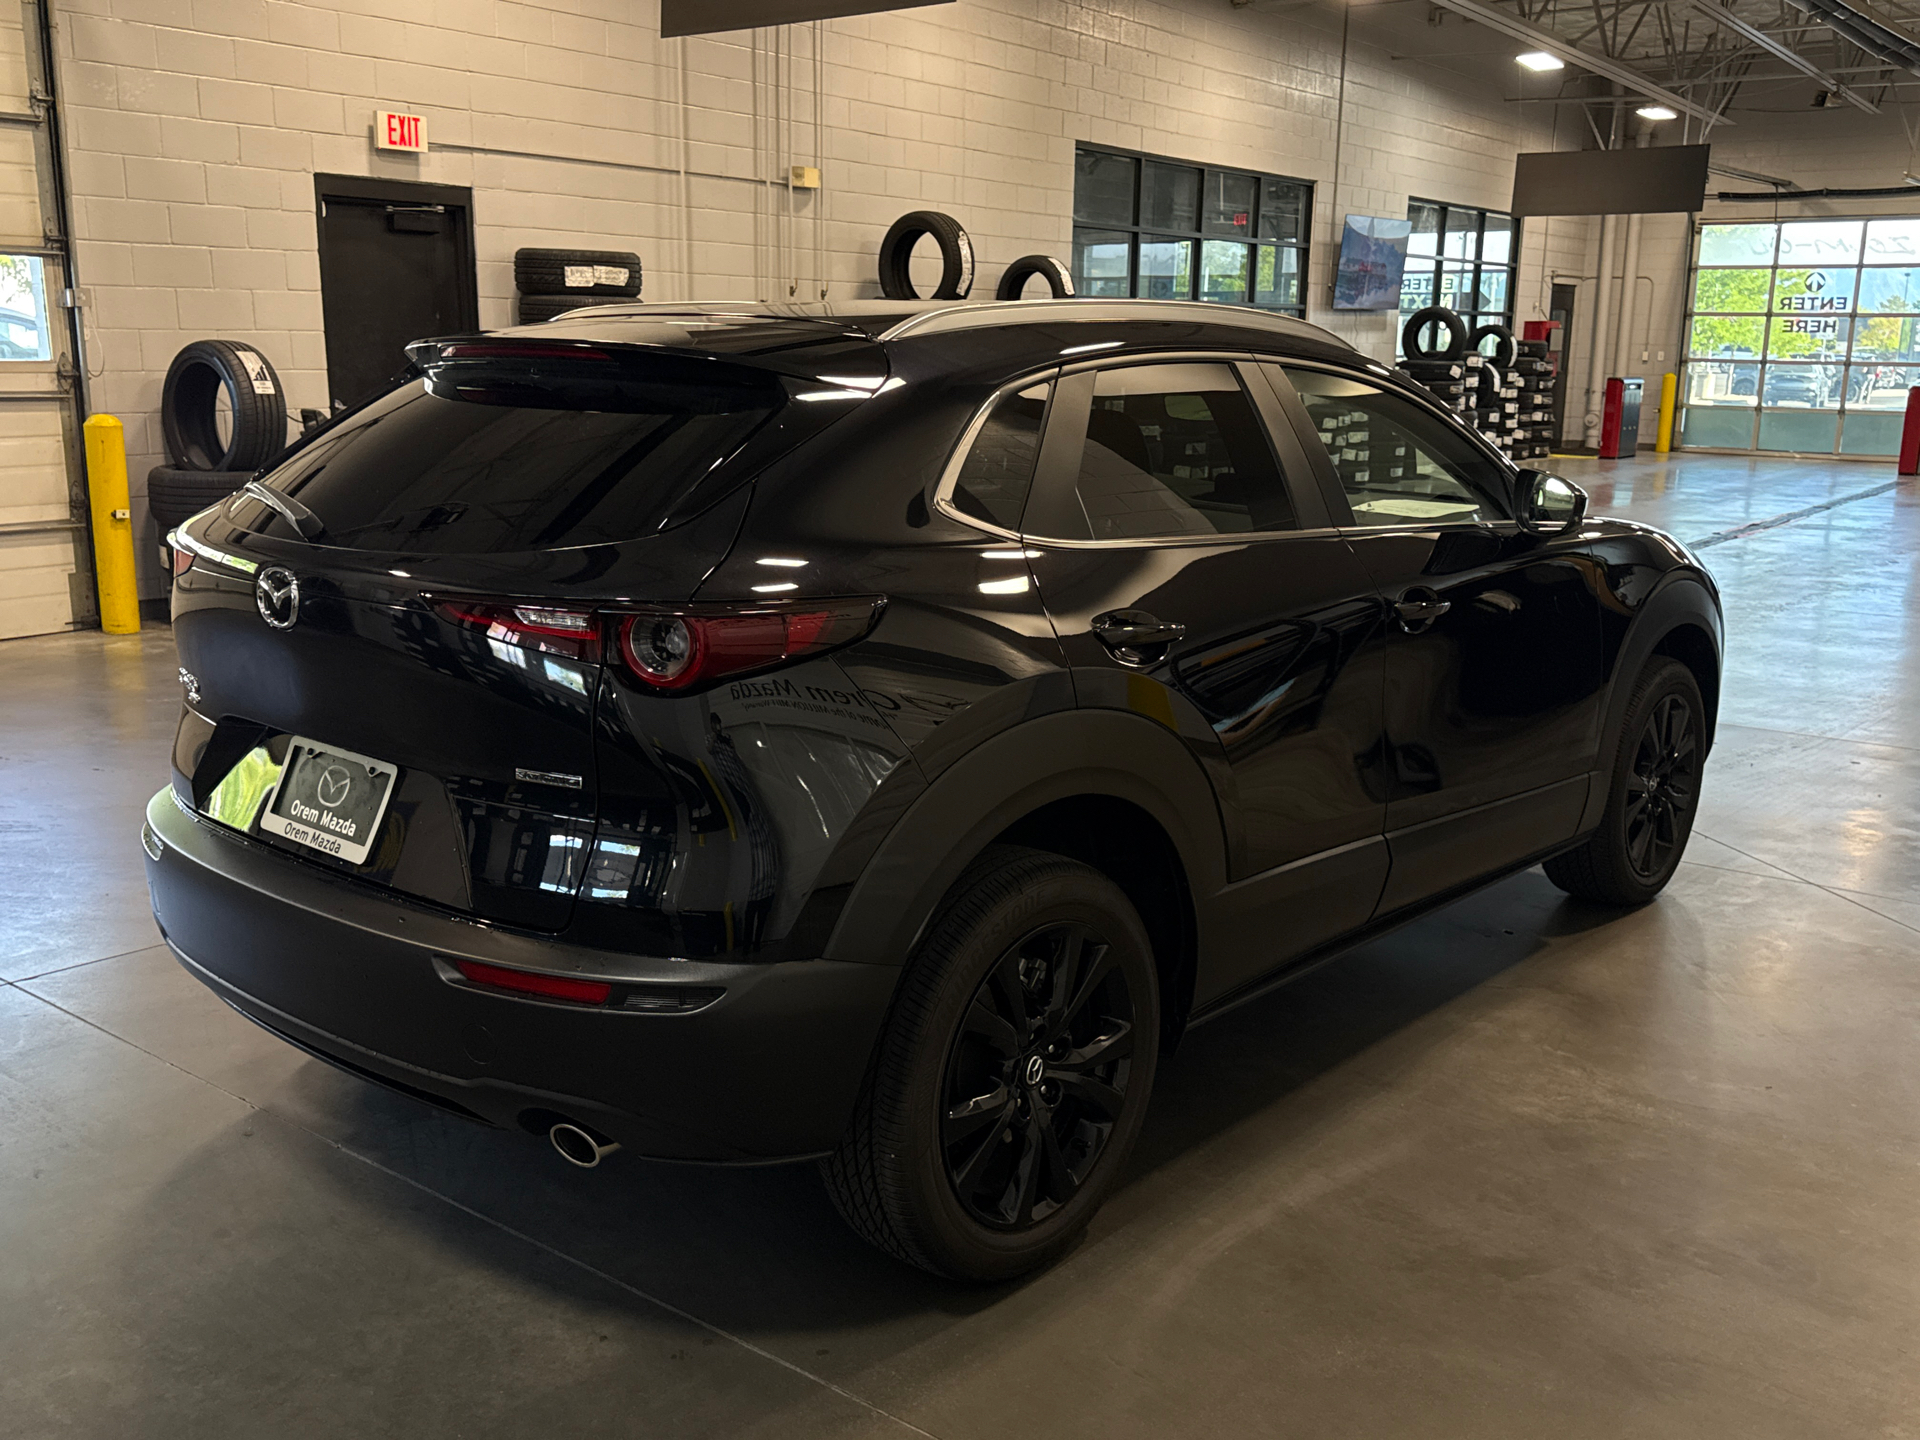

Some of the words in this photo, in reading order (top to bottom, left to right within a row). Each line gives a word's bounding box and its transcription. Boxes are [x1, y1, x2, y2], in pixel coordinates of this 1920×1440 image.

[387, 114, 420, 148] EXIT
[290, 799, 319, 824] Orem
[319, 809, 357, 837] Mazda
[284, 822, 309, 842] Orem
[309, 833, 342, 854] Mazda
